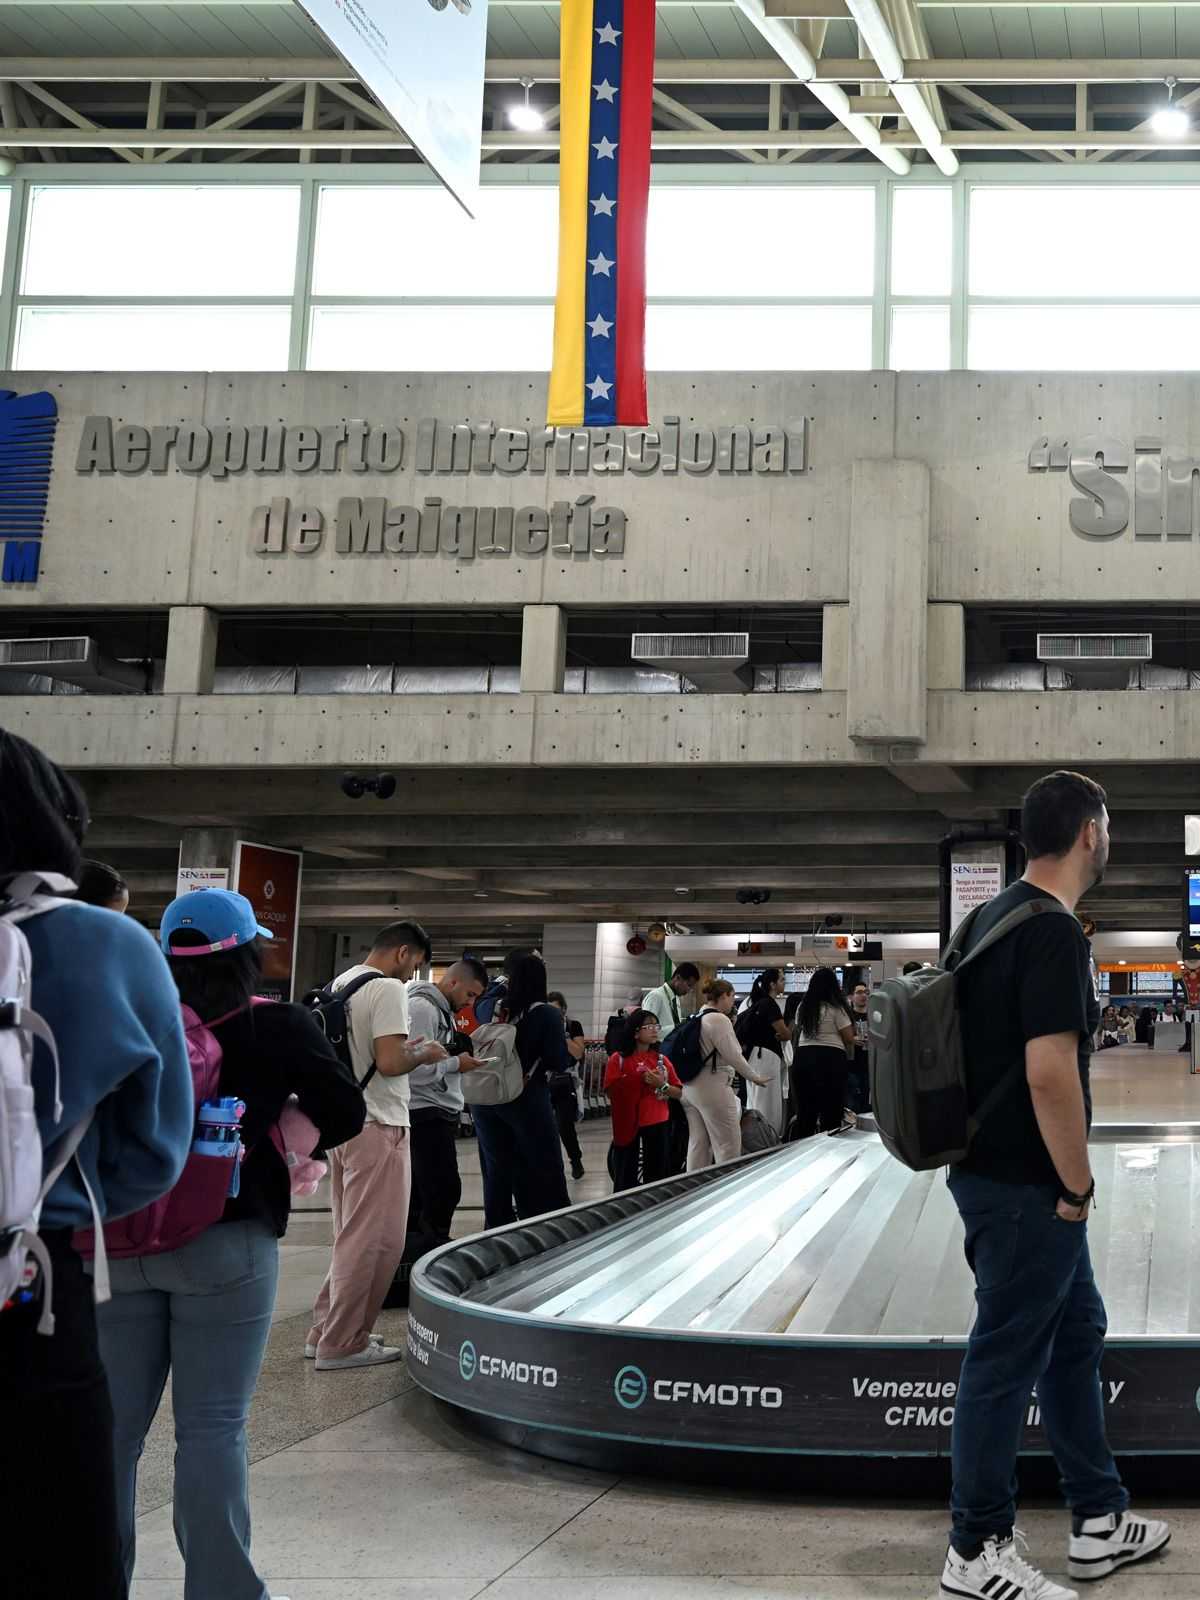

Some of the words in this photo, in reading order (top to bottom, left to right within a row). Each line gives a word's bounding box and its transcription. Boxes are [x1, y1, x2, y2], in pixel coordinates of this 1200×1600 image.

[76, 415, 405, 477] Aeropuerto
[416, 414, 809, 475] Internacional
[254, 496, 325, 554] de
[335, 495, 627, 558] Maiquetía
[956, 886, 986, 894] PASAPORTE
[479, 1354, 558, 1388] CFMOTO
[653, 1380, 784, 1409] CFMOTO
[851, 1377, 958, 1398] Venezue
[1106, 1380, 1125, 1403] y
[884, 1406, 955, 1427] CFMO
